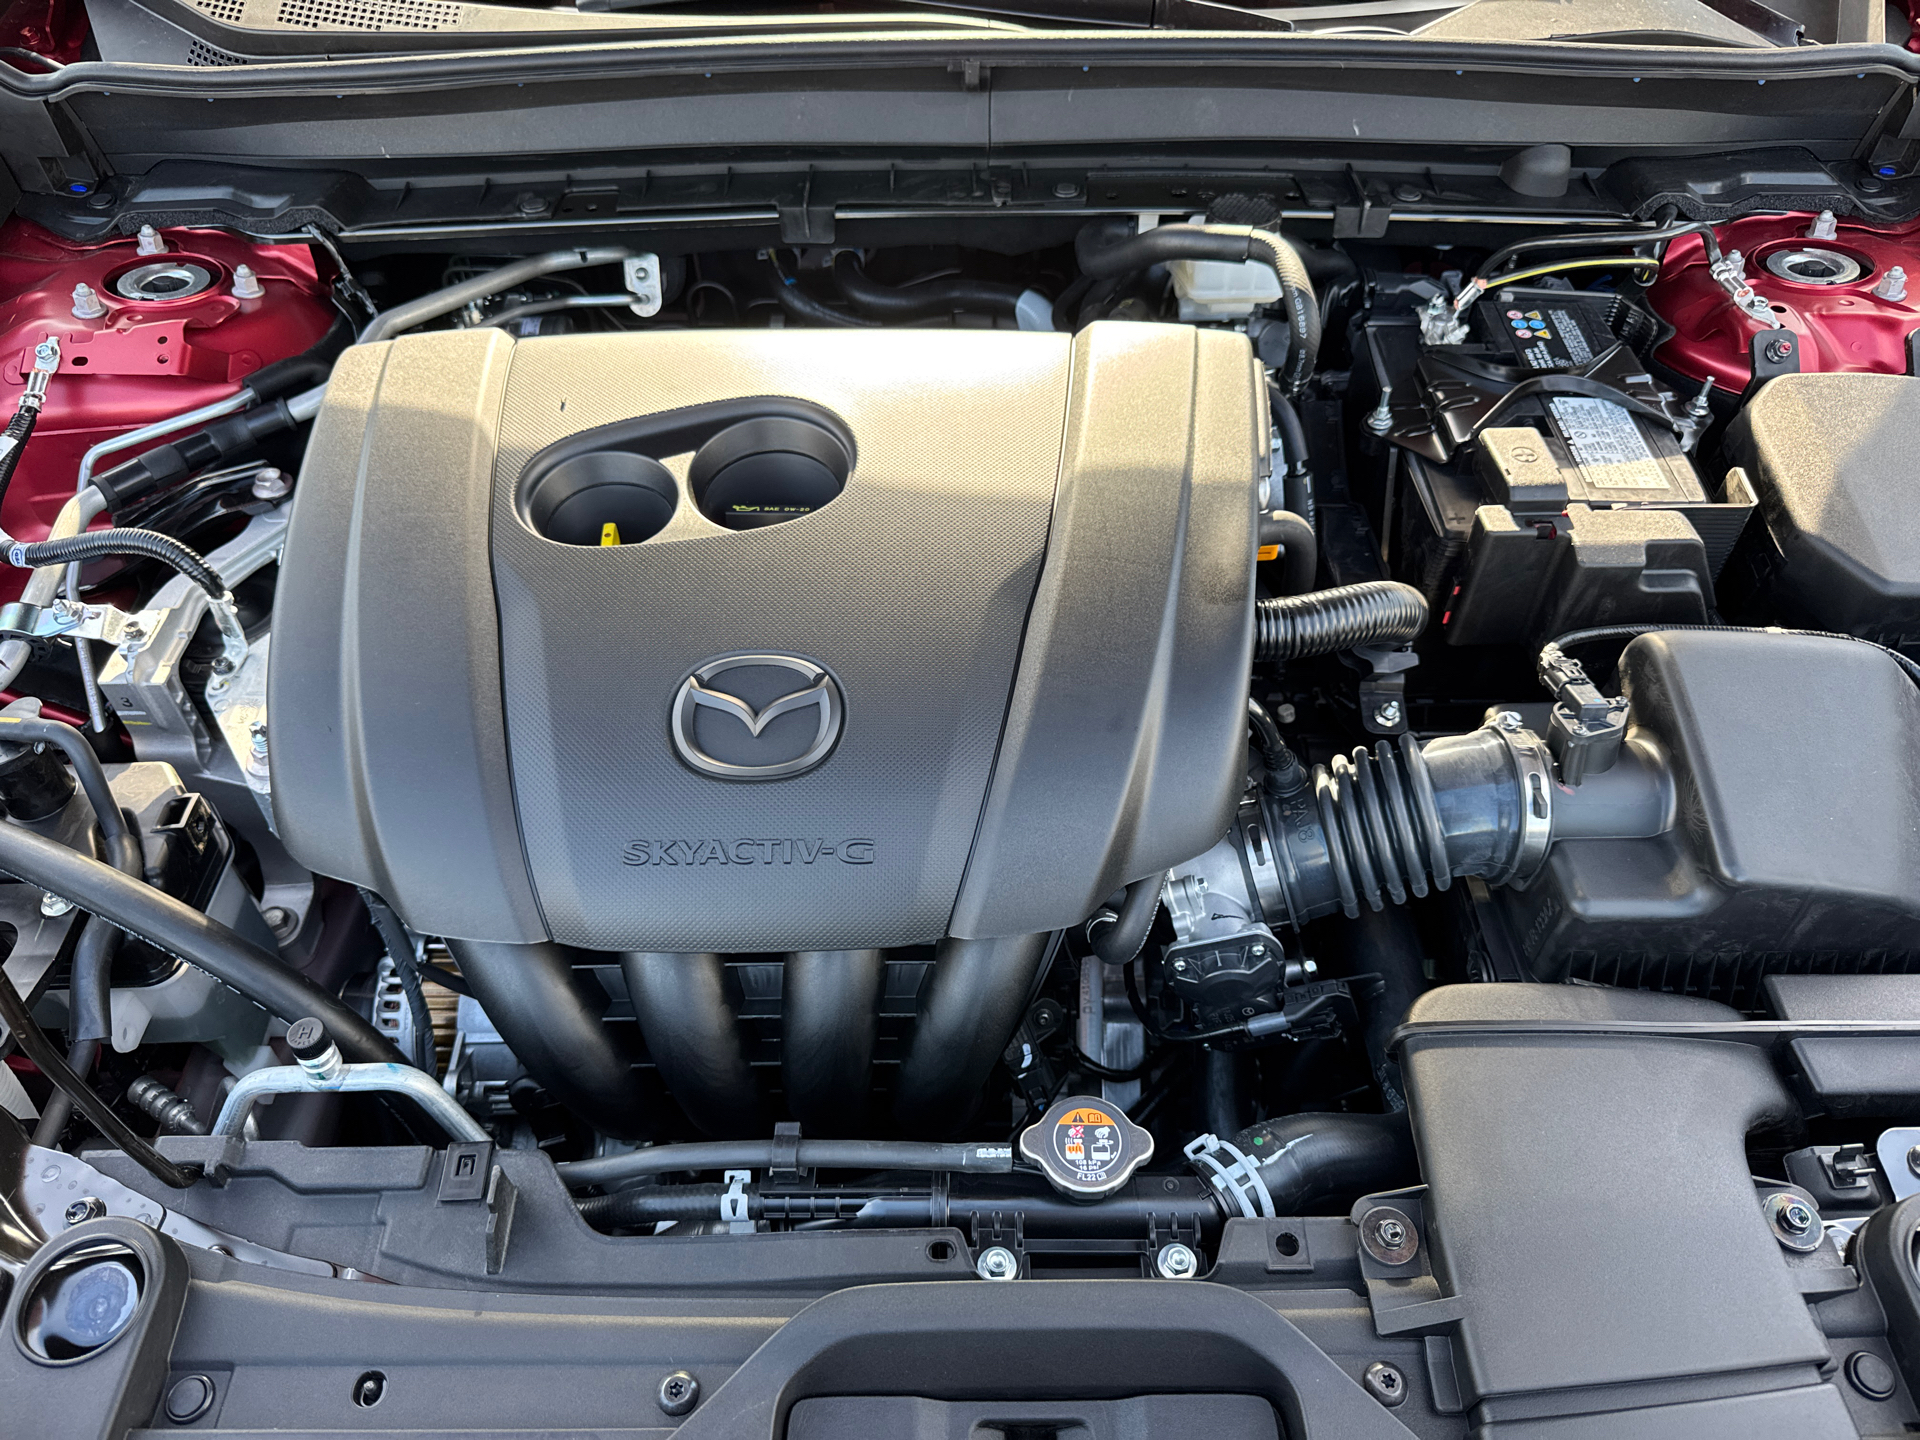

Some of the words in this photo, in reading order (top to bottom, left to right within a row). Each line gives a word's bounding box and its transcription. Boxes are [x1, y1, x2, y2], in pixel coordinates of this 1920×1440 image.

[1295, 295, 1307, 339] GB16897
[622, 837, 875, 866] SKYACTIV-G
[298, 1026, 315, 1040] H
[1076, 1171, 1096, 1181] FL22
